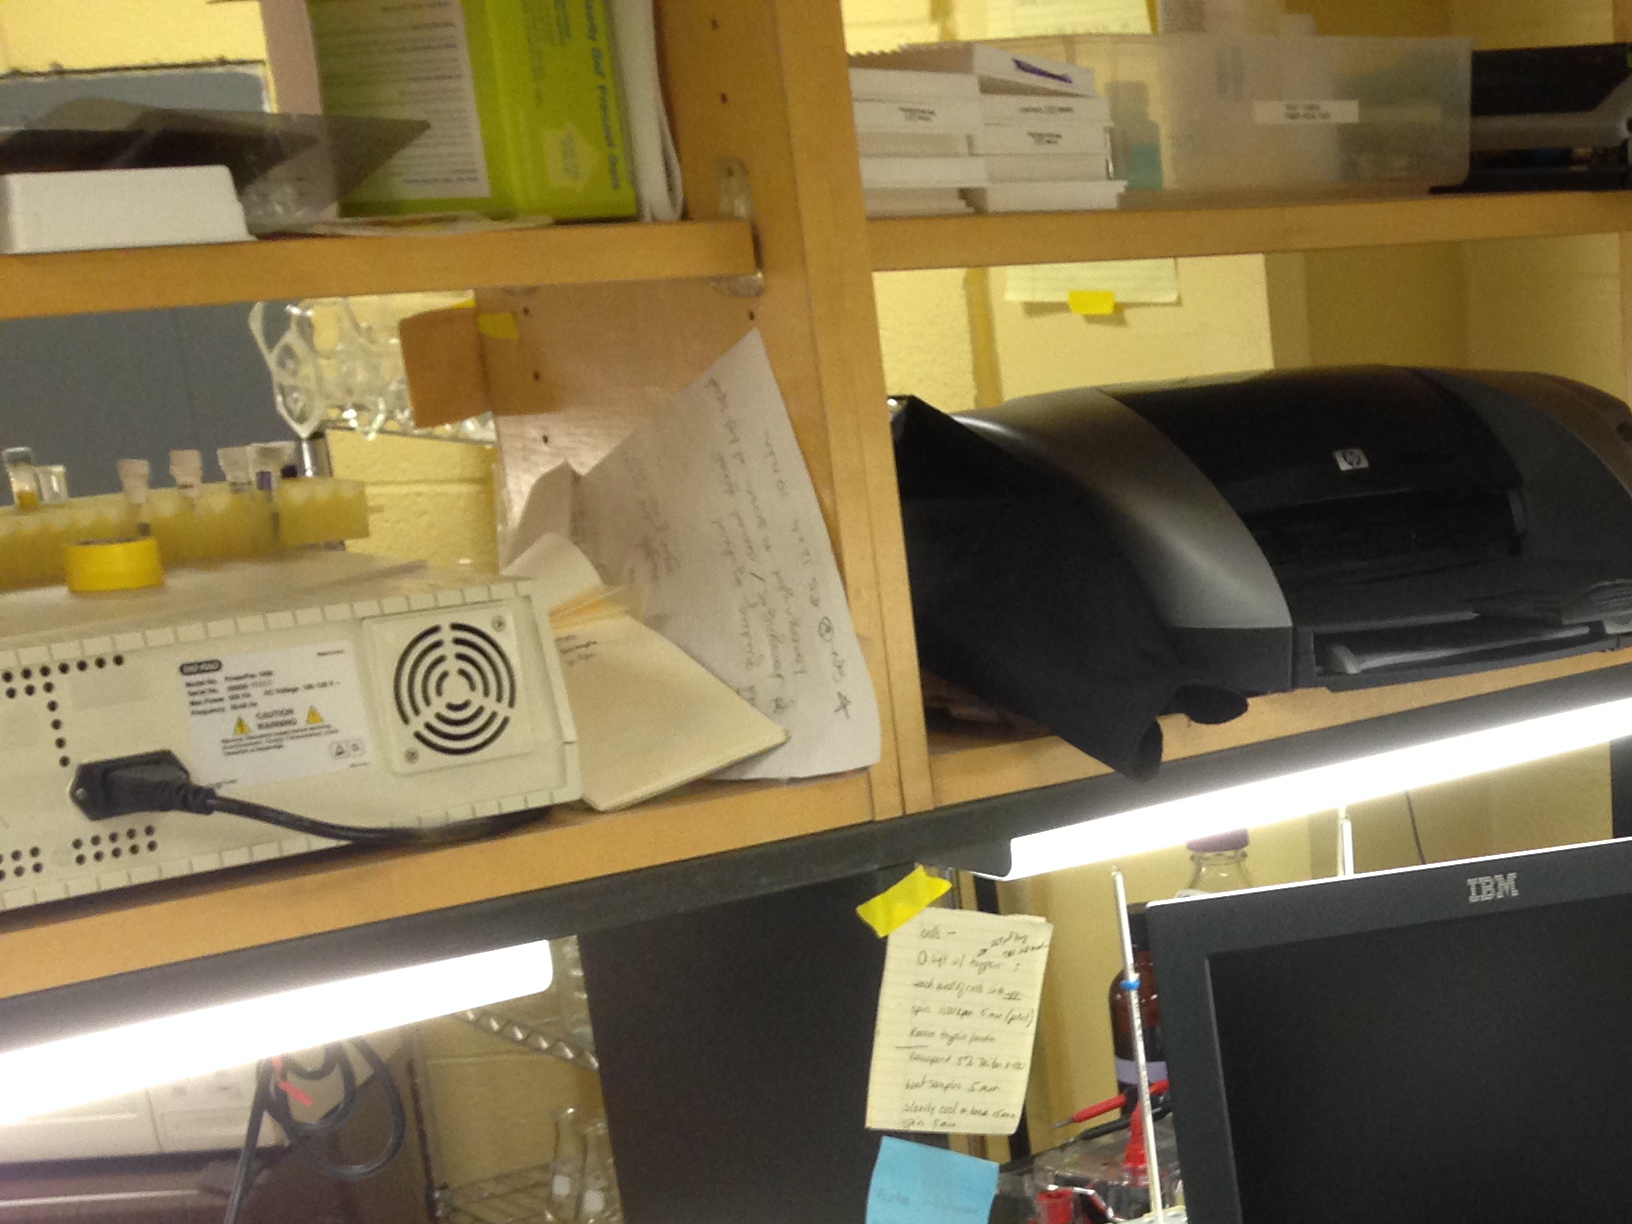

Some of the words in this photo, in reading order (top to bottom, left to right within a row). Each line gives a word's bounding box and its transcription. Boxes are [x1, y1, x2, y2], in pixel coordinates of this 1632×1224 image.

[256, 708, 294, 720] CAUTION
[257, 718, 297, 730] WARNING
[1466, 872, 1519, 903] IBM
